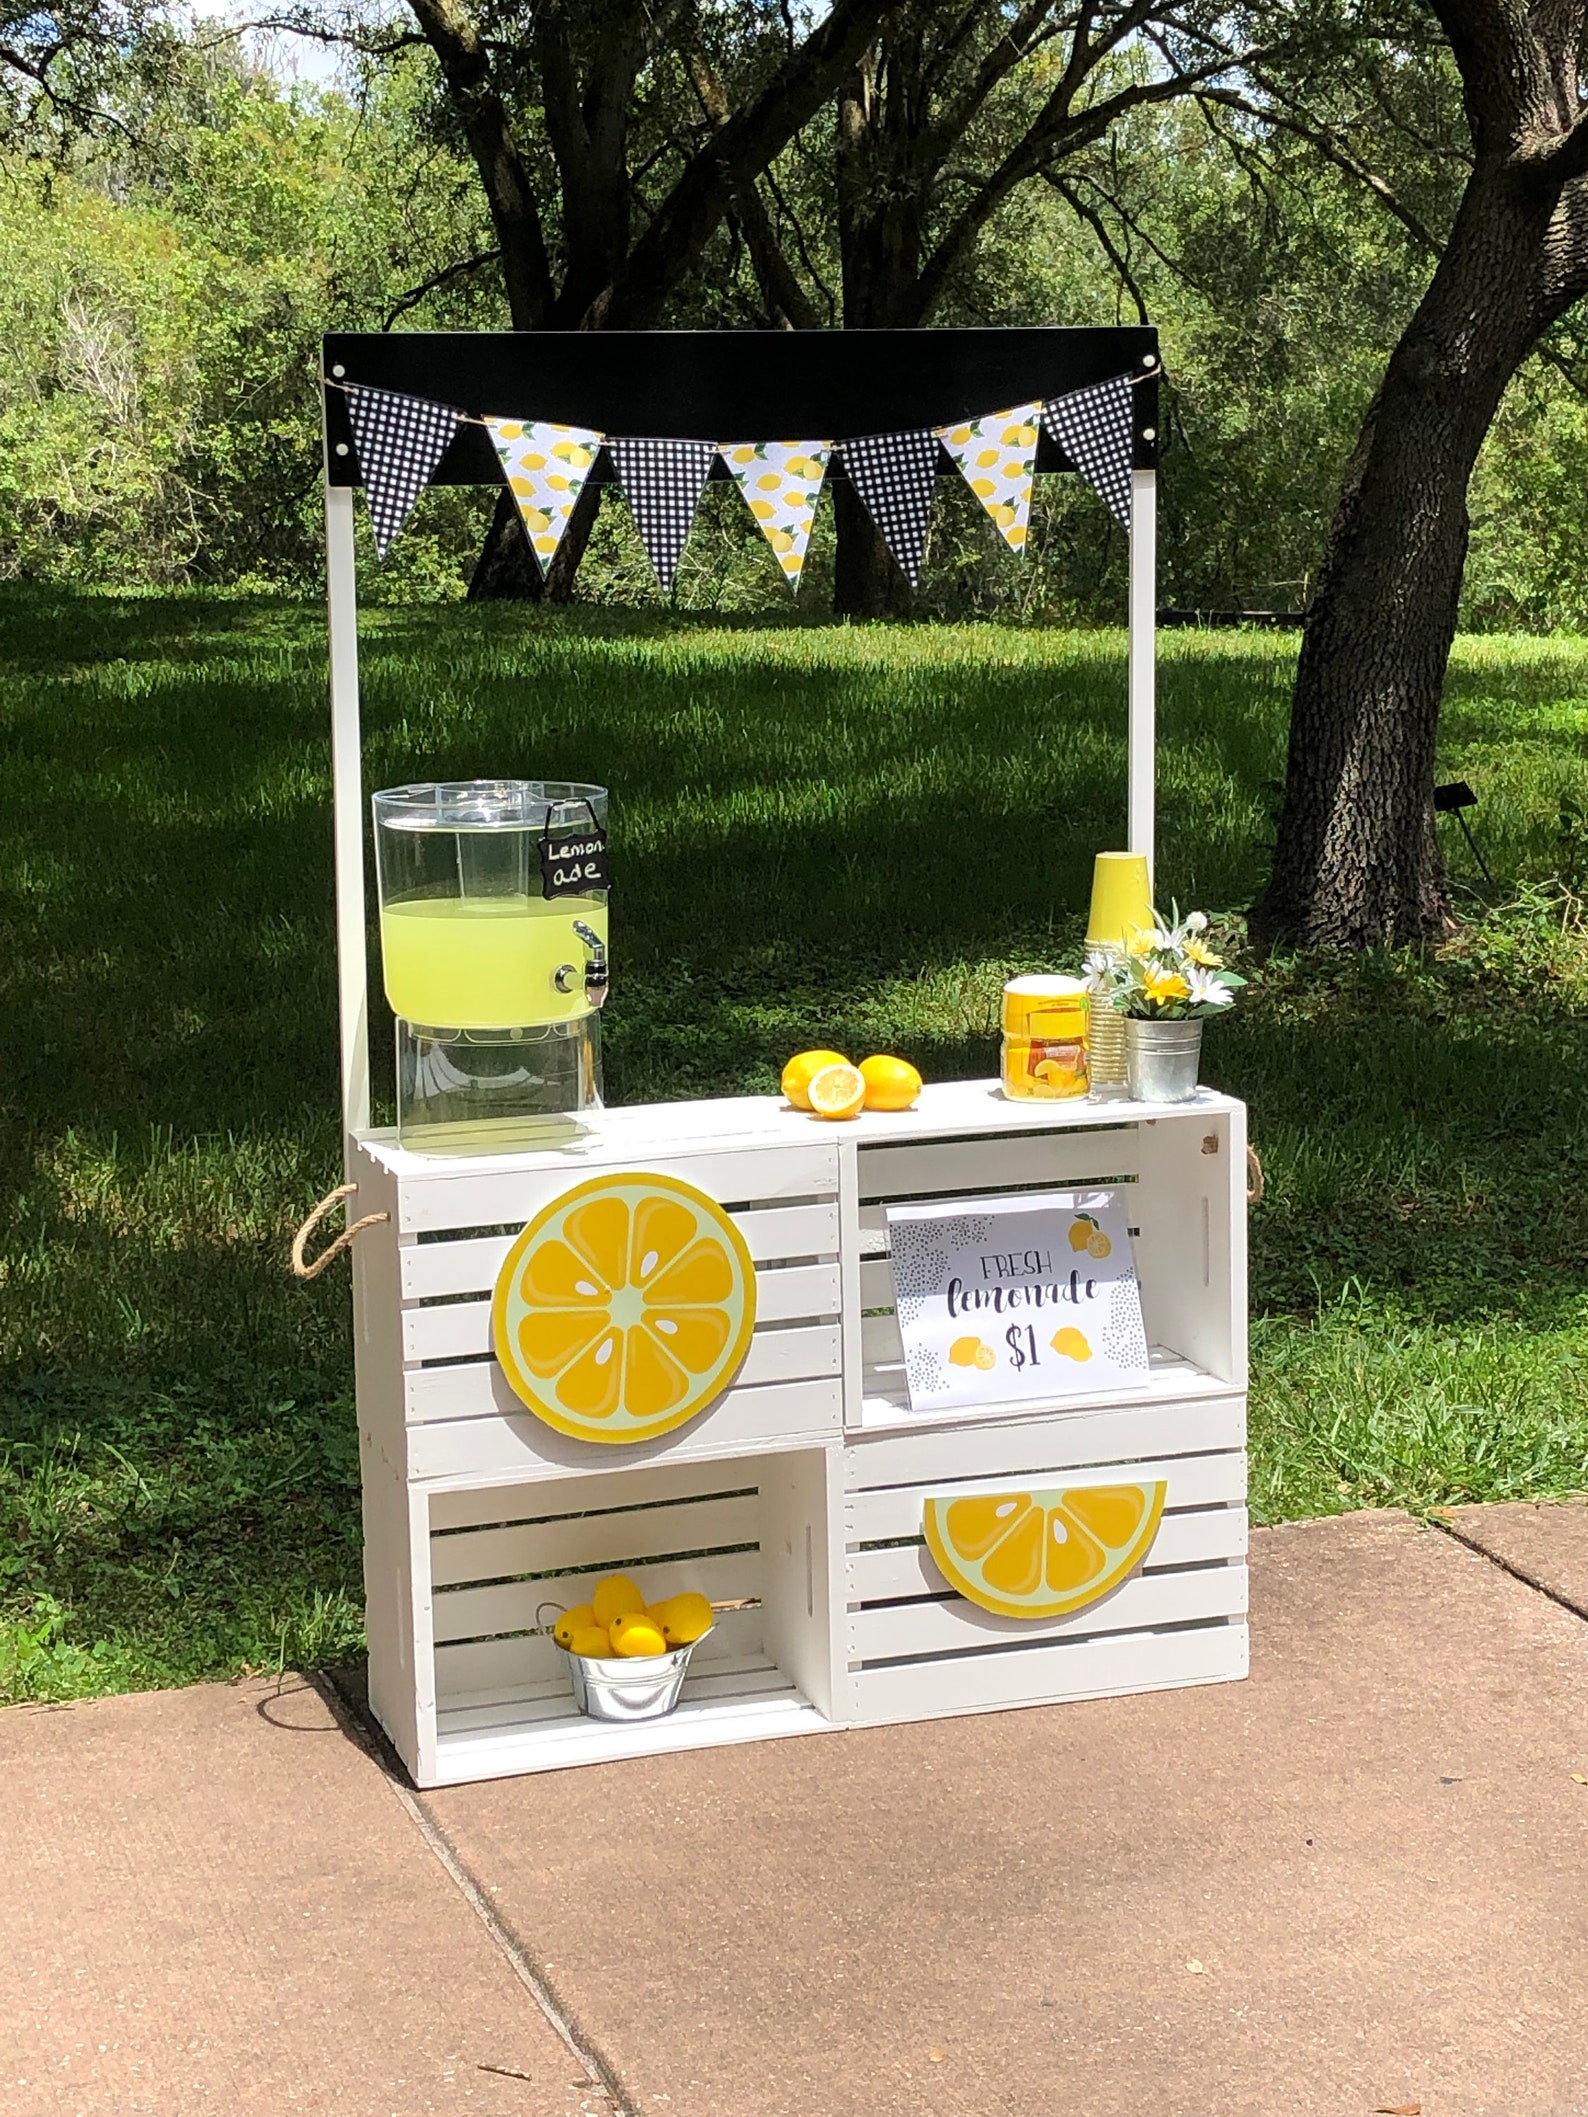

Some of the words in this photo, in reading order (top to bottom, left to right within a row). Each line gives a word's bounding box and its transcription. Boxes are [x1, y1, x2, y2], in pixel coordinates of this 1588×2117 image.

[553, 862, 602, 886] ade
[980, 1250, 1053, 1280] FRESH
[947, 1269, 1099, 1318] lemonade
[1005, 1323, 1041, 1372] $1
